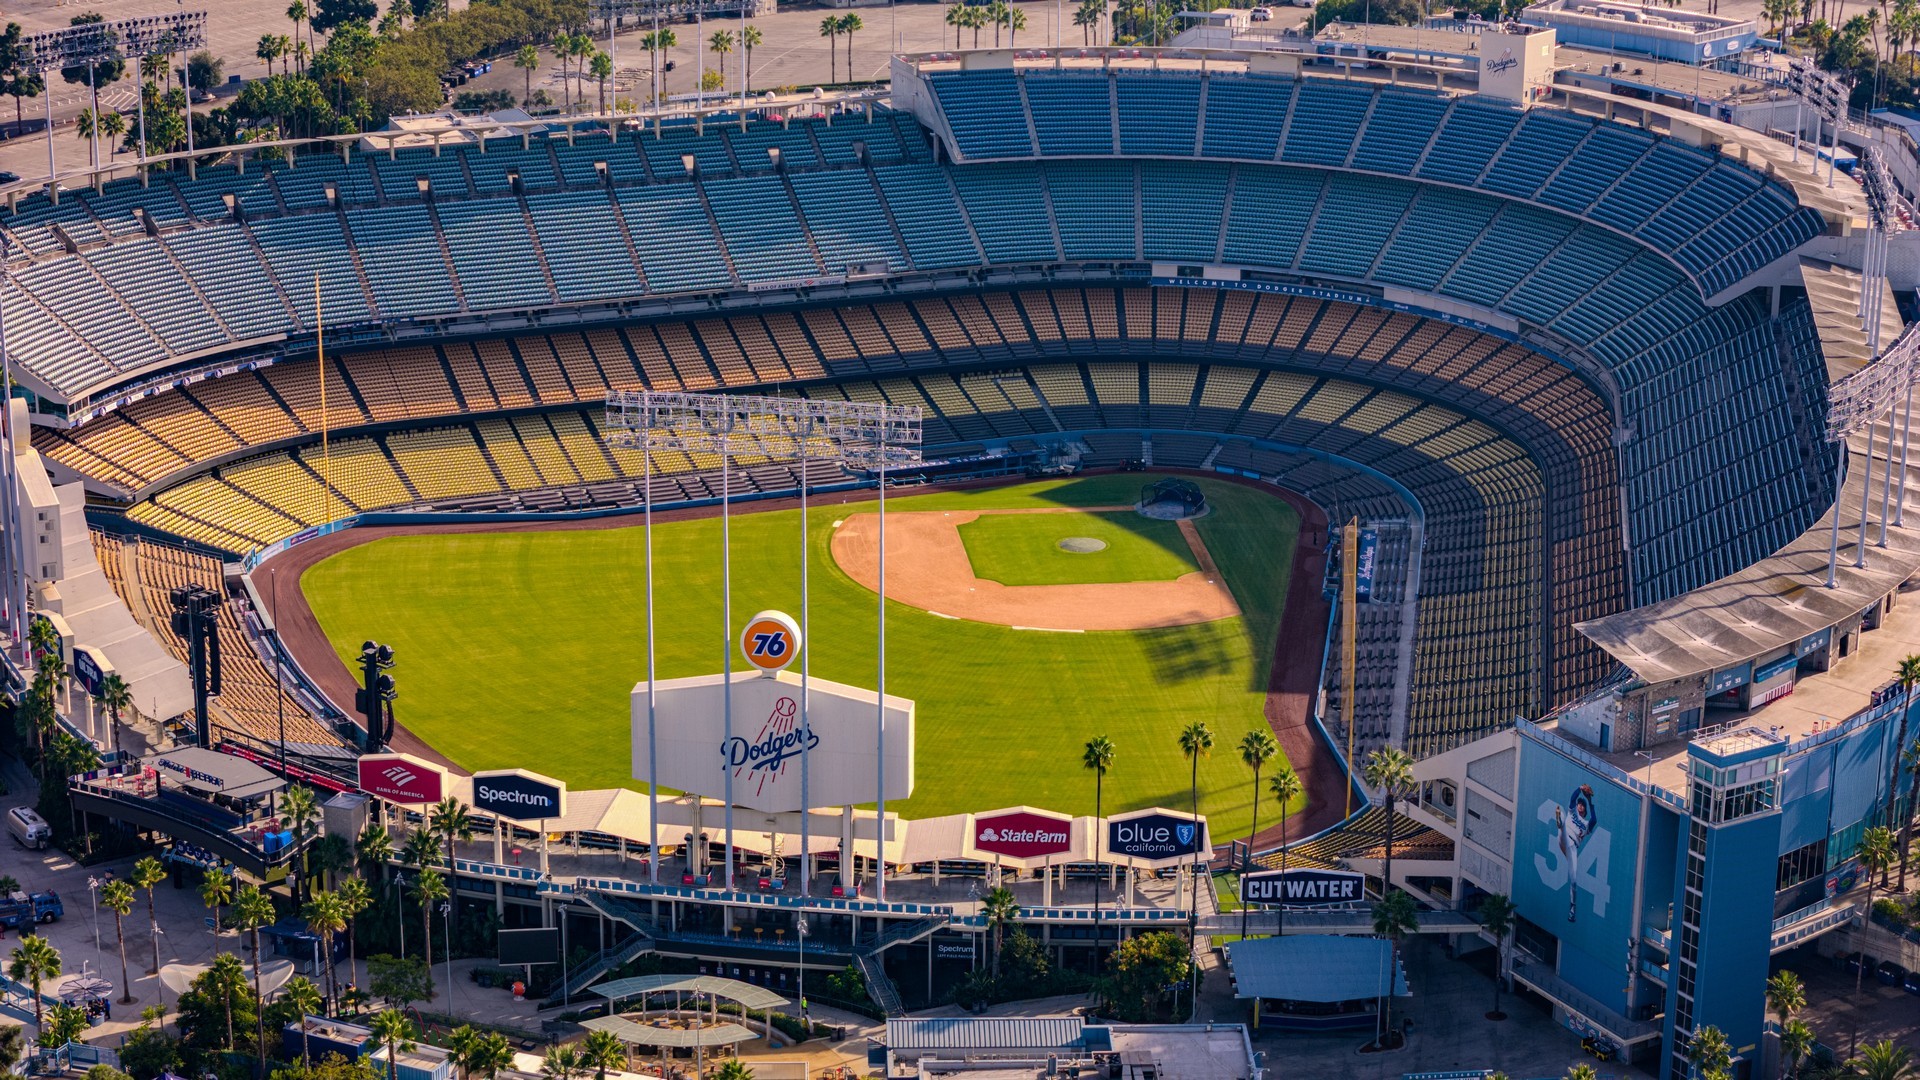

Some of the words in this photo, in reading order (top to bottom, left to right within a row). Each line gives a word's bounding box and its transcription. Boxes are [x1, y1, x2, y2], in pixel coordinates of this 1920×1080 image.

[1486, 57, 1518, 73] Dodgers
[1168, 279, 1225, 287] WELCOME
[1256, 284, 1303, 293] DODGER
[1312, 289, 1362, 302] STADIUM
[752, 631, 787, 658] 76
[720, 722, 820, 772] Dodgers
[375, 786, 392, 795] BANK
[391, 788, 399, 796] OF
[399, 790, 425, 799] AMERICA
[478, 785, 549, 807] Spectrum
[1117, 823, 1170, 843] blue
[1125, 842, 1176, 852] california
[1534, 799, 1611, 918] 34
[1248, 880, 1354, 898] CUTWATER
[938, 944, 976, 953] Spectrum
